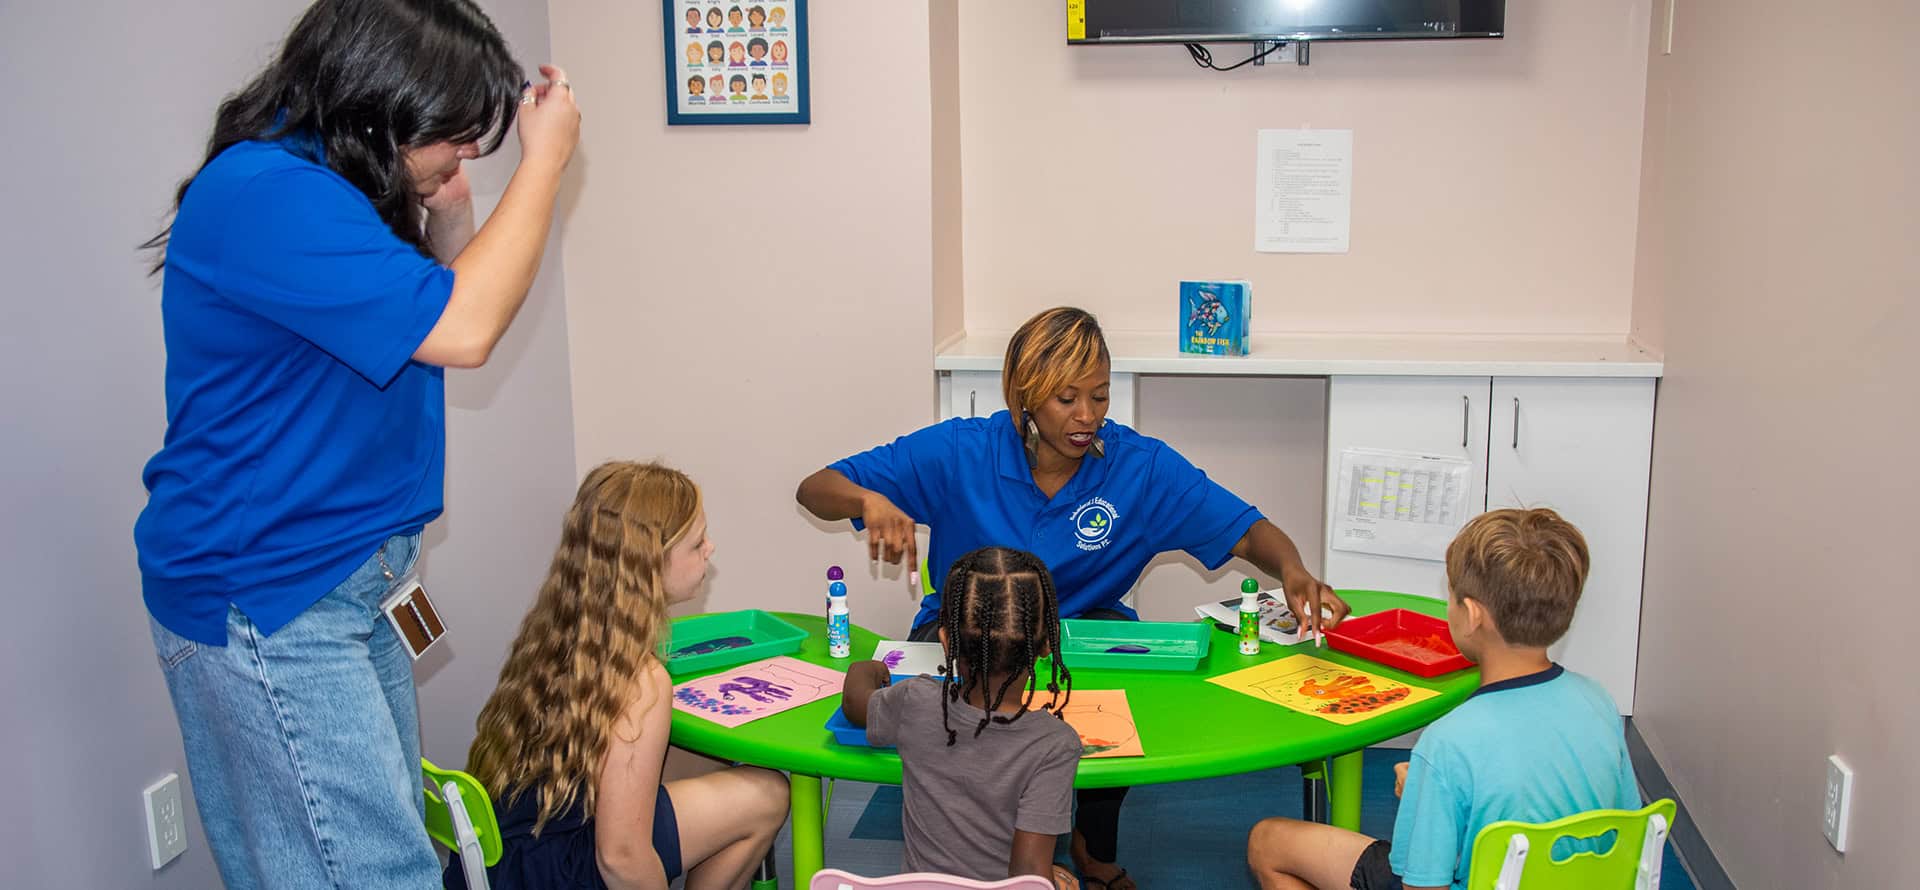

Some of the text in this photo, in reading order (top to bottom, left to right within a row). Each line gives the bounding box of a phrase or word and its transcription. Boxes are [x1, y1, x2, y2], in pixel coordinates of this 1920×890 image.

[1191, 336, 1216, 344] RAINBOW
[1094, 496, 1120, 520] Educational
[1076, 541, 1101, 551] Solutions
